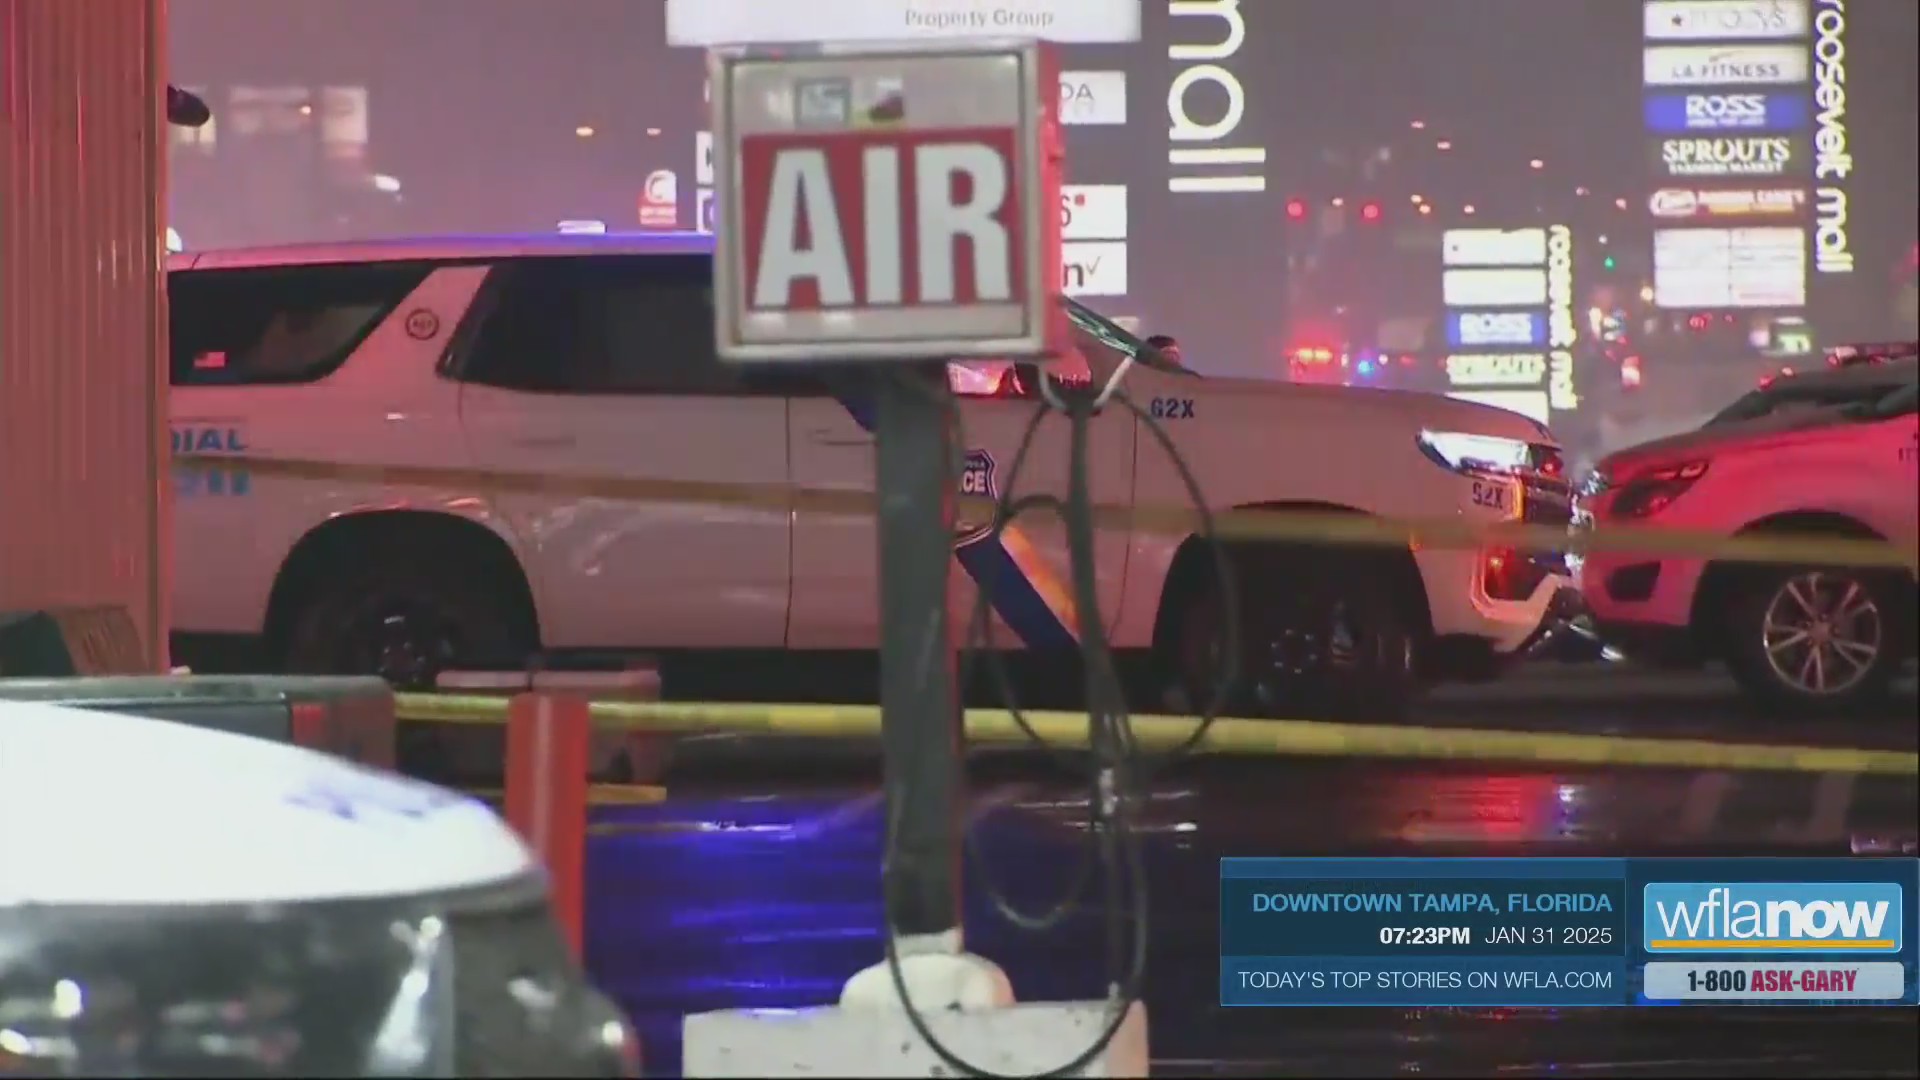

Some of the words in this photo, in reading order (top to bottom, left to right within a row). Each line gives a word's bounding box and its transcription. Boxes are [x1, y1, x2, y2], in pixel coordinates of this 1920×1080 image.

[903, 8, 987, 30] Property
[992, 8, 1054, 30] Group
[1701, 63, 1781, 78] FITNESS
[1167, 0, 1266, 192] mall
[1685, 94, 1768, 118] ROSS
[1661, 137, 1792, 163] SPROUTS
[754, 142, 1011, 304] AIR
[1815, 187, 1854, 273] mall
[1150, 397, 1195, 419] G2X
